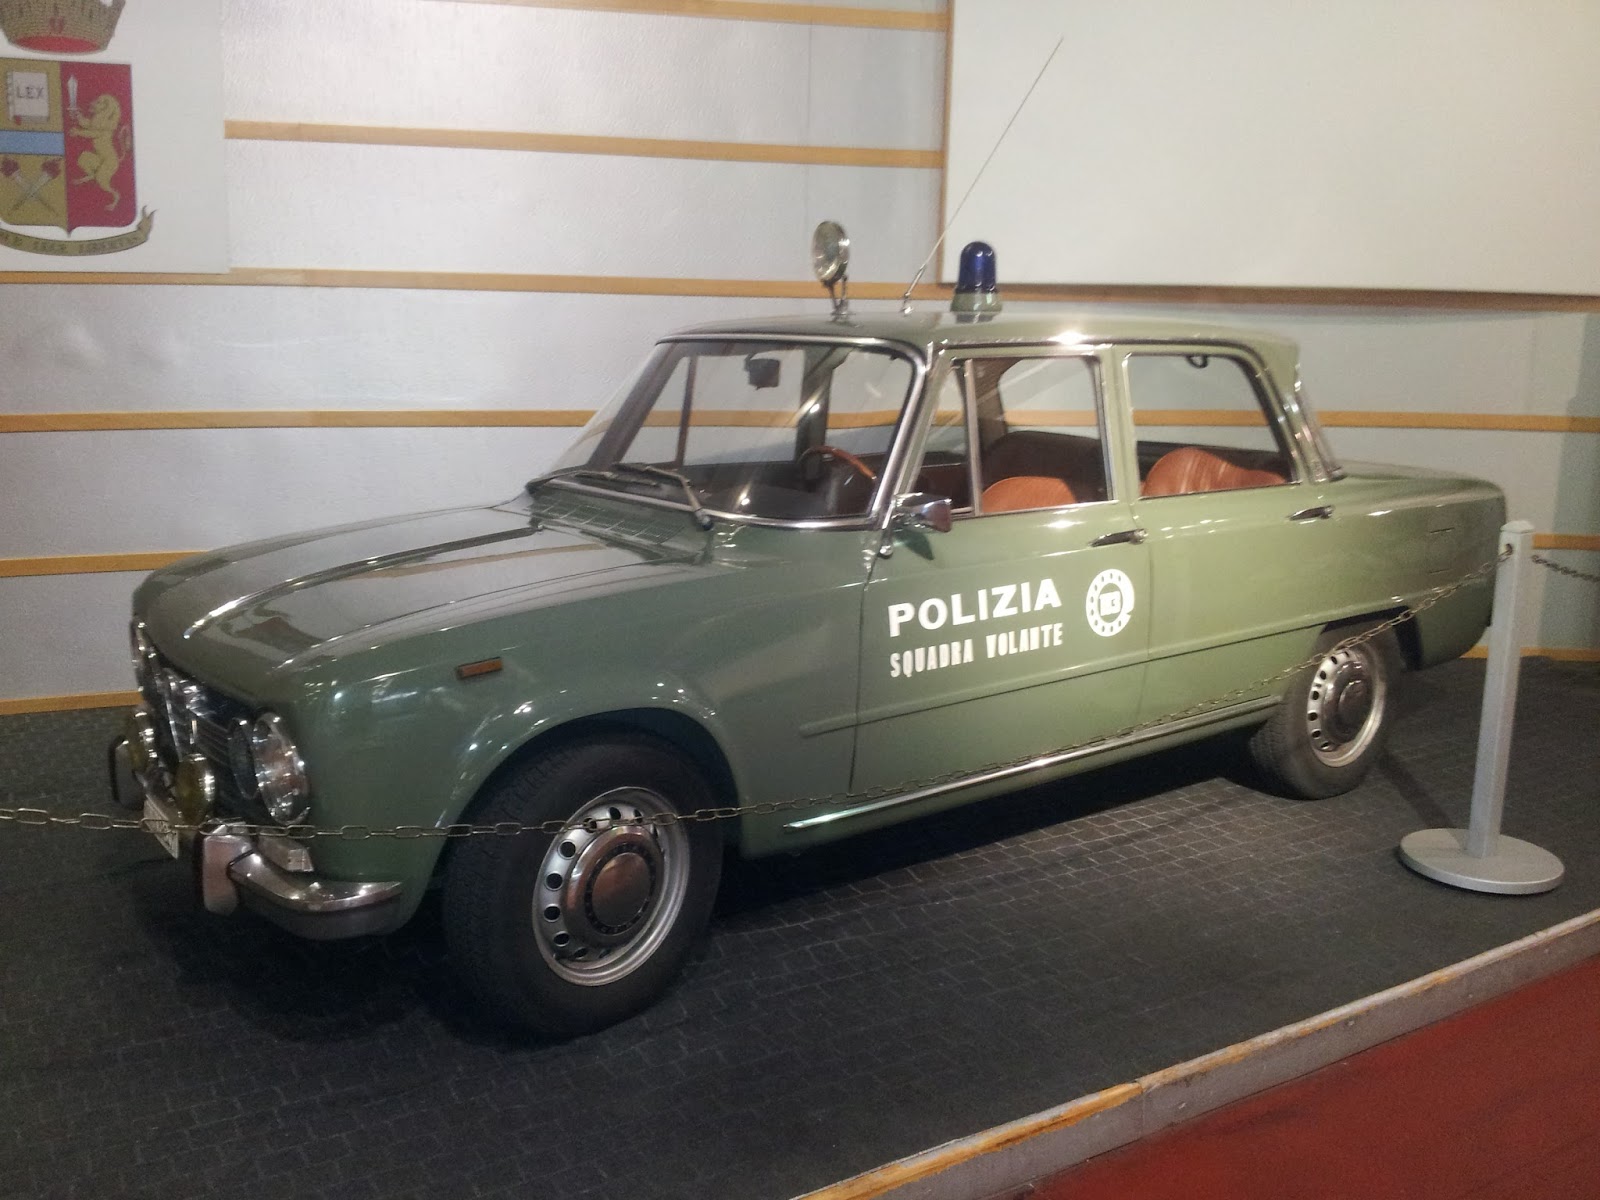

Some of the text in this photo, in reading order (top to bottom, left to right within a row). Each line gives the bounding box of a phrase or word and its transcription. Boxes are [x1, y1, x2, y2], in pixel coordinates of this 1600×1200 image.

[16, 86, 44, 99] LEX
[888, 578, 1062, 637] POLIZIA
[890, 622, 1063, 678] SQUADRA VOLANTE
